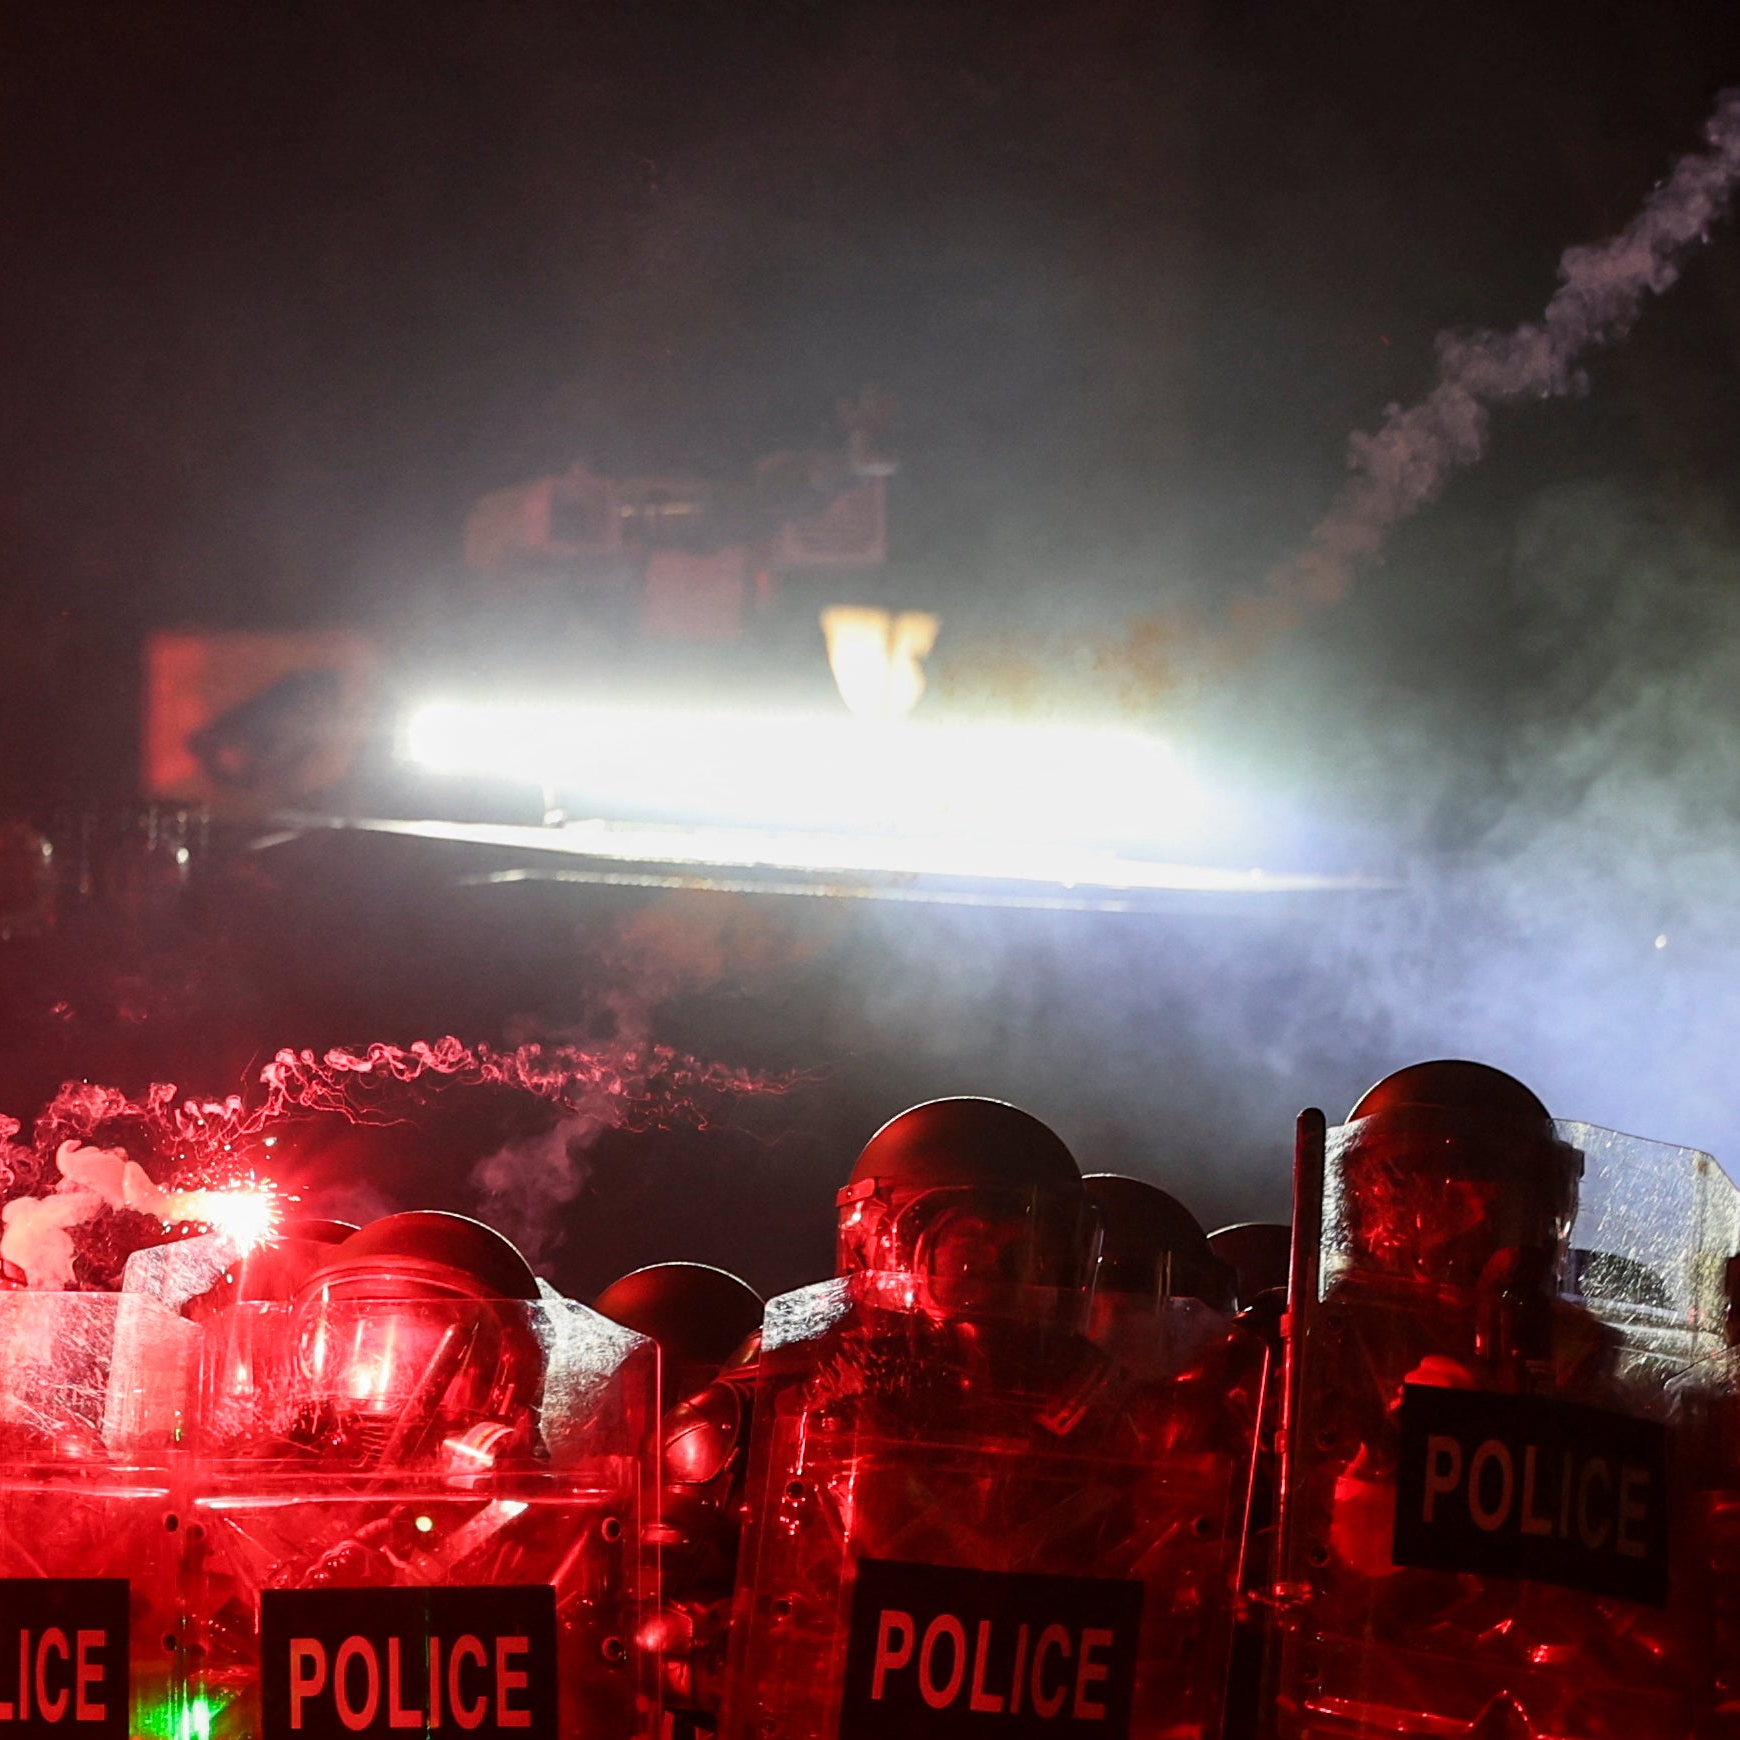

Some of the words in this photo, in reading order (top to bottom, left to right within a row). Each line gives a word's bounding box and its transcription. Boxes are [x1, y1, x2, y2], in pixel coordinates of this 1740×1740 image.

[1422, 1434, 1650, 1560] POLICE
[289, 1633, 532, 1732] POLICE
[871, 1609, 1114, 1721] POLICE
